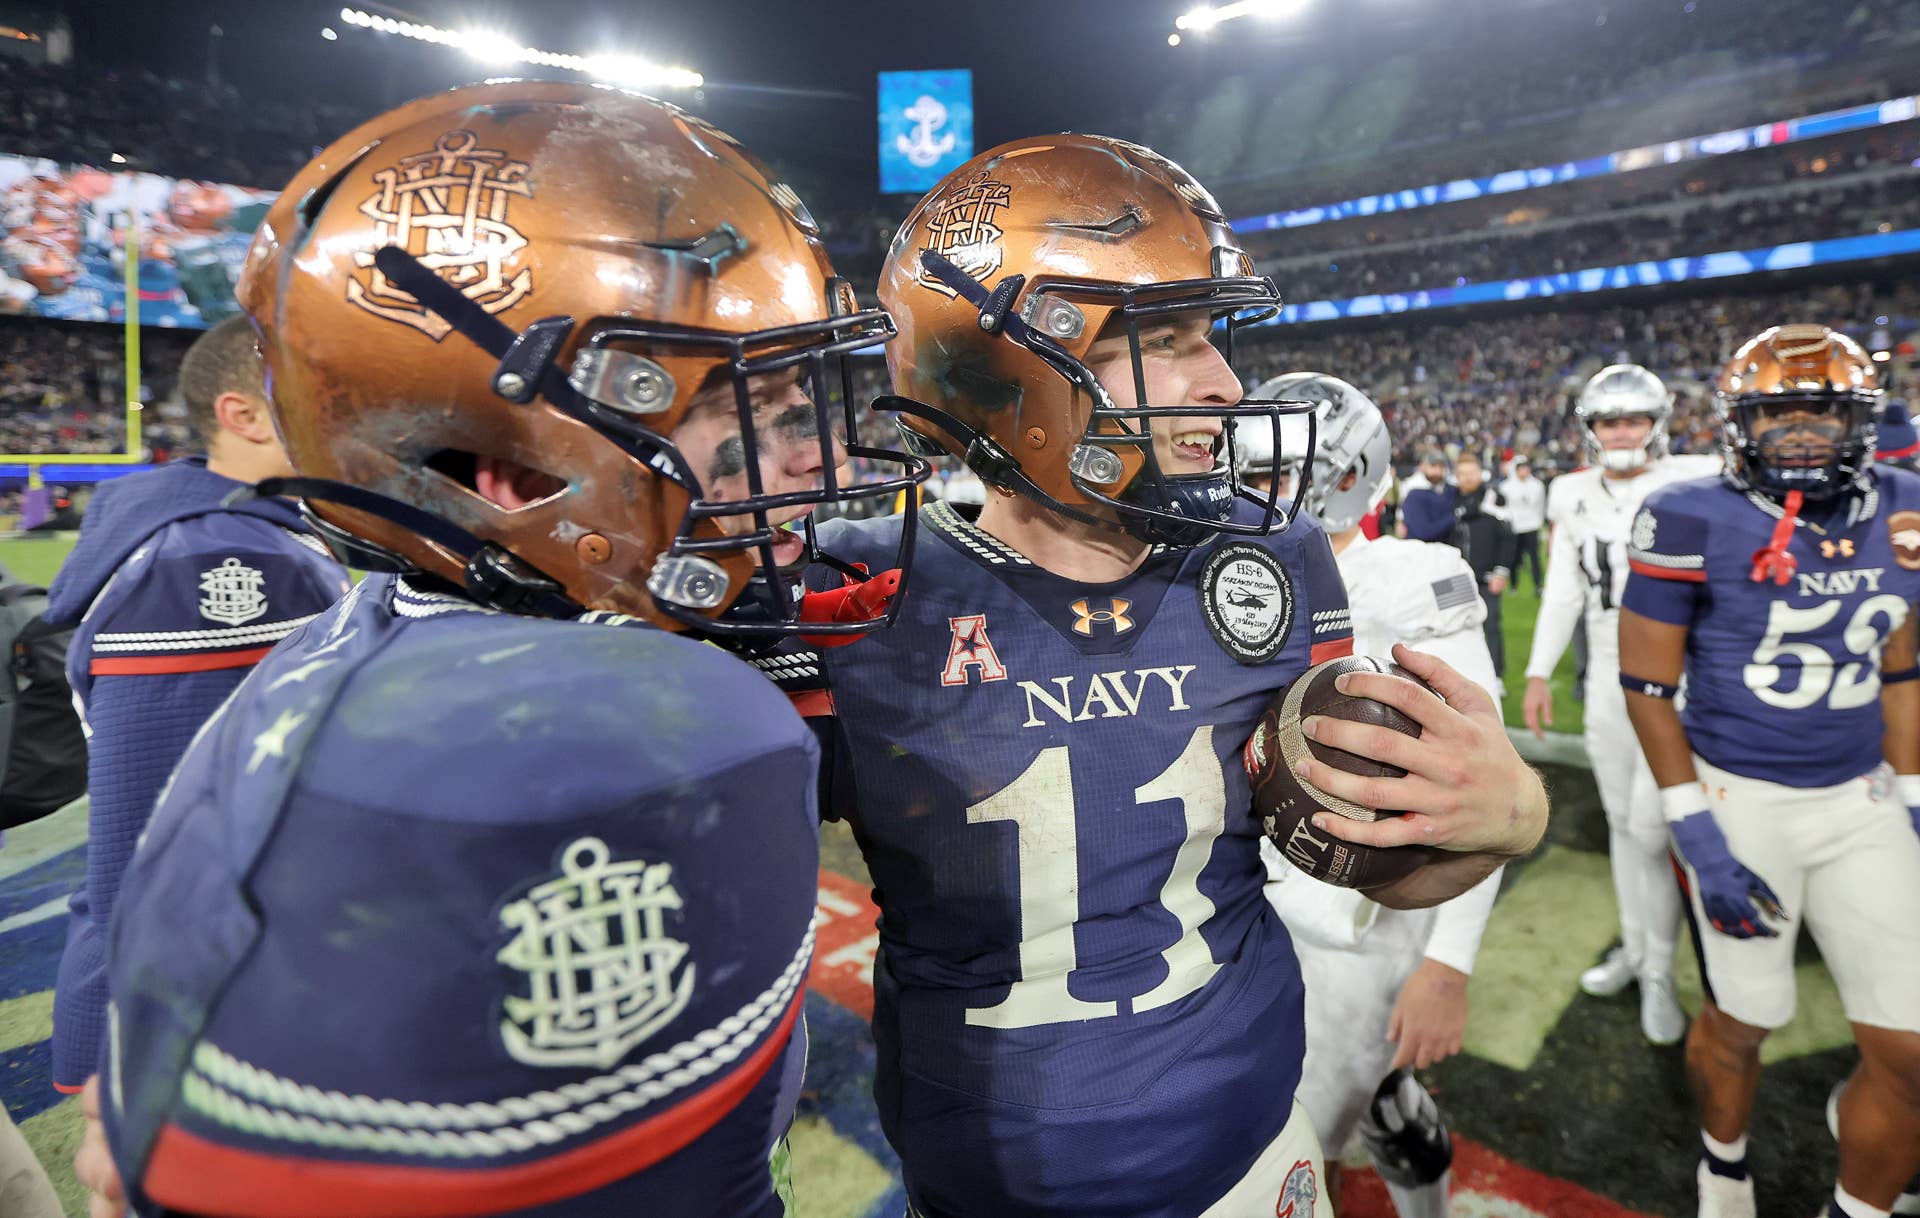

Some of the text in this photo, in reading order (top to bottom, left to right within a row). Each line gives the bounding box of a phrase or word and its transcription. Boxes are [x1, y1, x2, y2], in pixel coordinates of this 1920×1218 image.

[1236, 563, 1263, 578] HS-6
[1796, 568, 1886, 597] NAVY
[940, 614, 1008, 687] A
[1016, 664, 1197, 728] NAVY
[1285, 817, 1329, 873] AVY
[965, 725, 1226, 1030] 11
